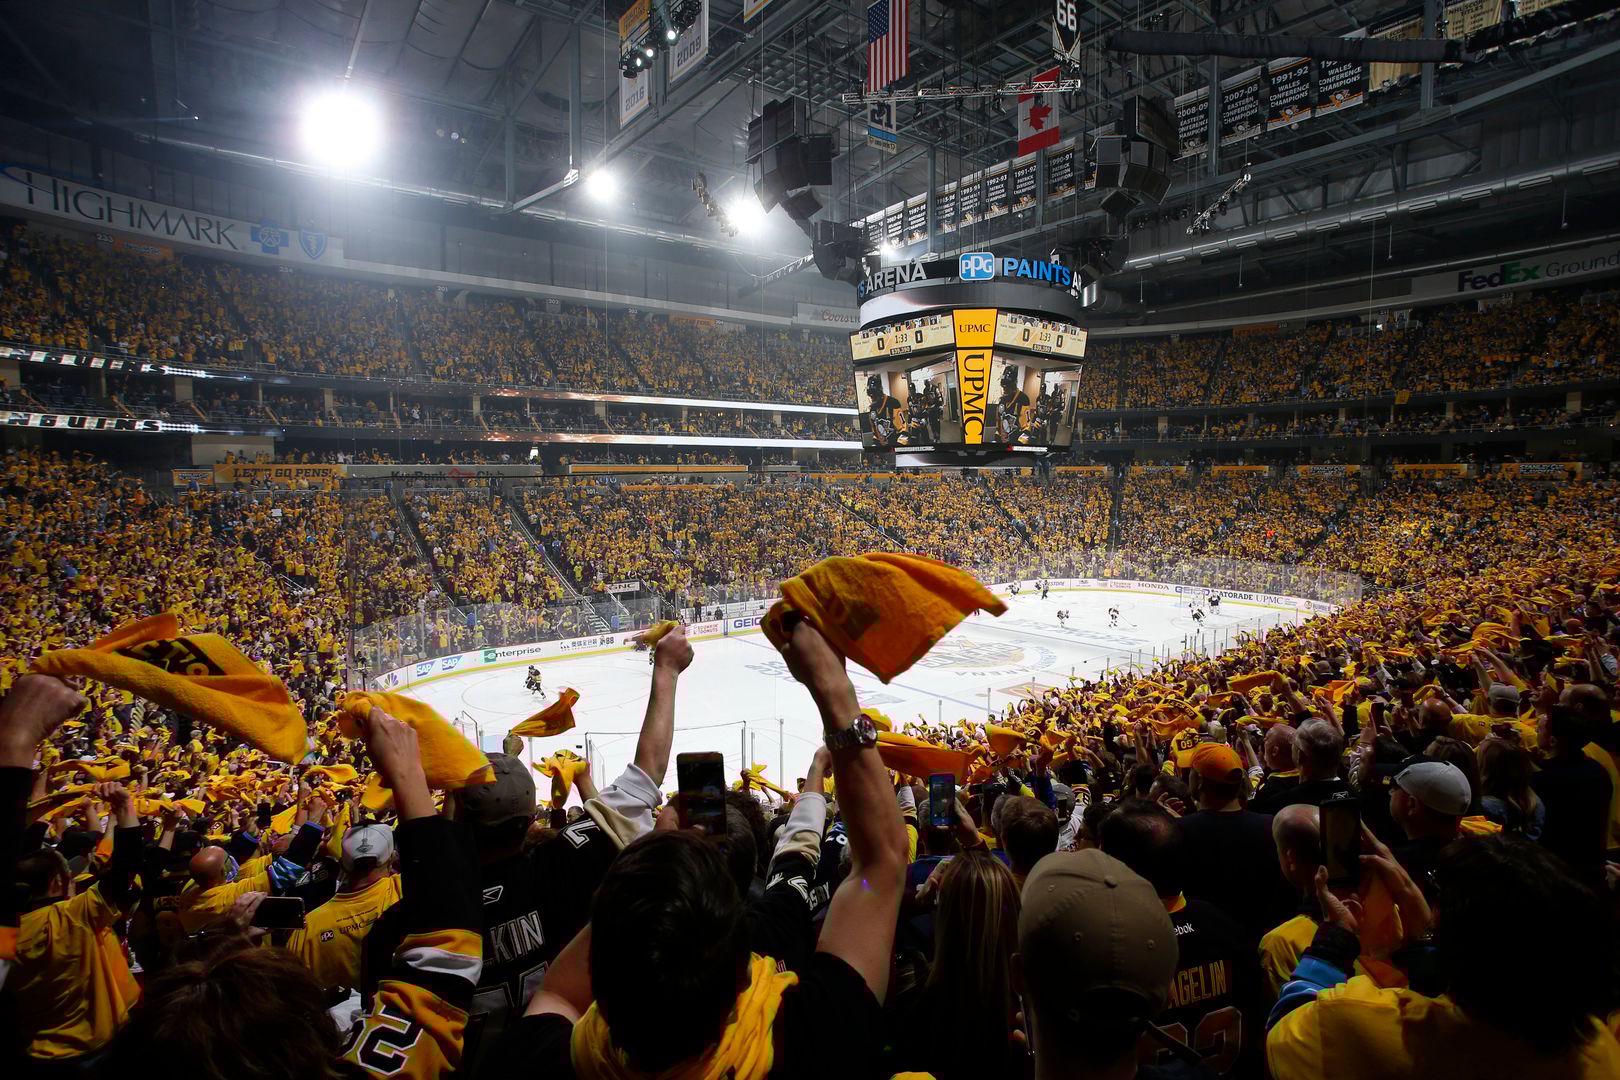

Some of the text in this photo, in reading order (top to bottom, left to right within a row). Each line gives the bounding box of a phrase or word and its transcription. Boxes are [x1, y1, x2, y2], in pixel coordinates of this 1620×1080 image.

[1056, 0, 1077, 31] 66
[677, 37, 701, 68] 2009
[1271, 65, 1309, 85] 1991-92
[1318, 65, 1362, 86] CONFERENCE
[1328, 62, 1352, 76] WALES
[1269, 82, 1310, 102] CONFERENCE
[1278, 79, 1302, 93] WALES
[1319, 73, 1361, 93] CHAMPIONS
[625, 86, 645, 112] 2016
[1223, 83, 1258, 104] 2007-08
[1227, 95, 1254, 111] EASTERN
[1271, 89, 1309, 108] CHAMPIONS
[1177, 101, 1209, 119] 2008-09
[1222, 99, 1259, 119] CONFERENCE
[1223, 108, 1258, 125] CHAMPIONS
[986, 174, 1008, 186] 1992-93
[26, 171, 239, 250] HIGHMARK
[865, 260, 927, 295] ARENA
[962, 255, 993, 277] PPG
[1003, 257, 1071, 287] PAINTS
[1458, 250, 1620, 292] FedEx Ground
[960, 323, 991, 333] UPMC
[1040, 332, 1051, 342] 1:33
[895, 333, 908, 344] 1:33
[964, 352, 985, 436] UPMC
[295, 468, 332, 478] PENS!
[1137, 582, 1169, 591] HONDA
[1256, 595, 1285, 605] UPMC
[733, 616, 762, 628] GEIC
[442, 658, 458, 668] SAP
[487, 646, 542, 660] enterprise
[416, 664, 432, 674] SAP
[489, 910, 546, 966] KIN
[1173, 922, 1195, 936] ebok
[1168, 959, 1227, 1010] AGELIN
